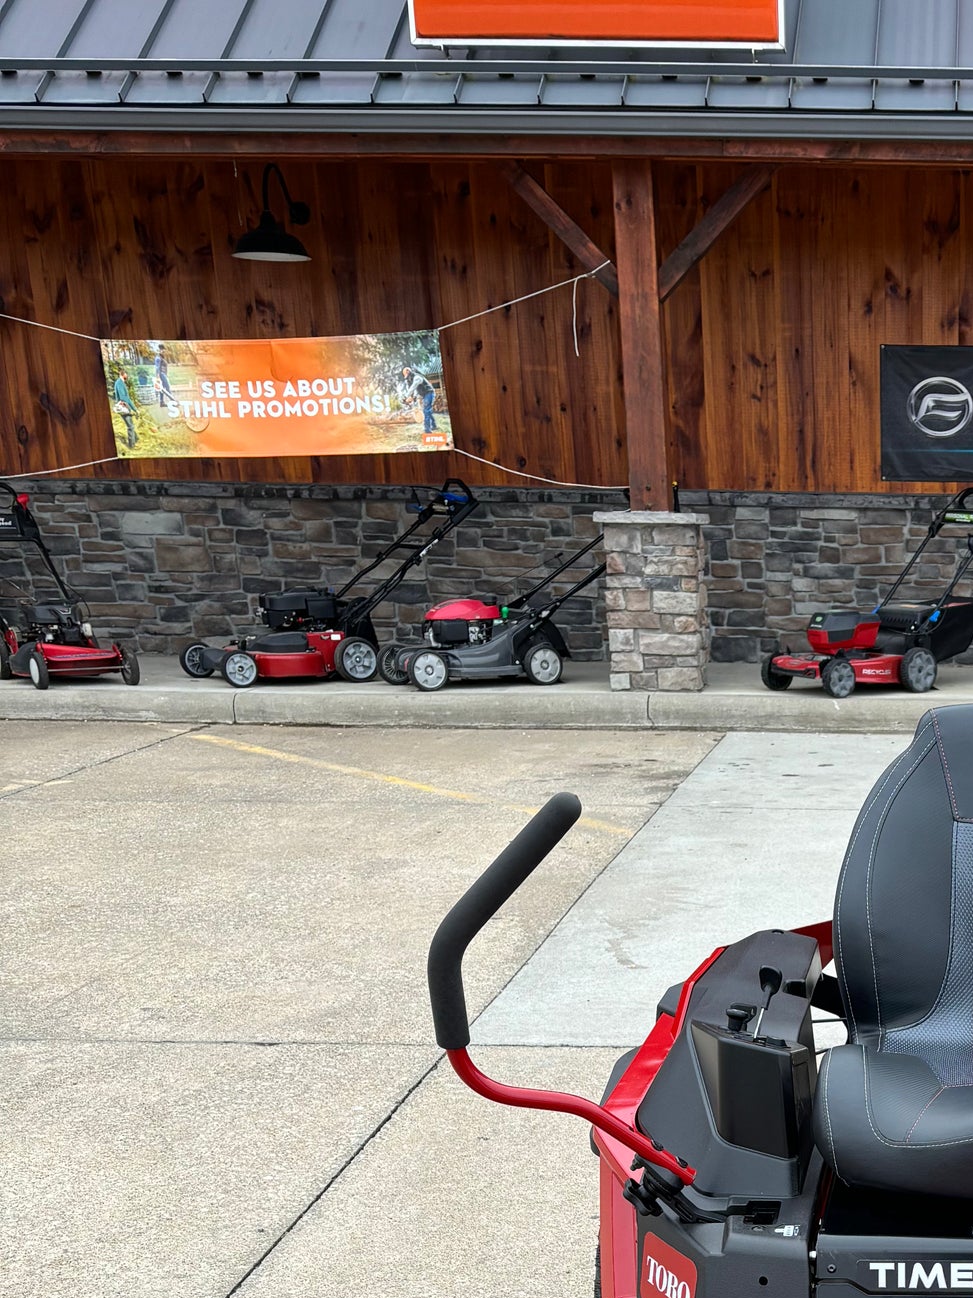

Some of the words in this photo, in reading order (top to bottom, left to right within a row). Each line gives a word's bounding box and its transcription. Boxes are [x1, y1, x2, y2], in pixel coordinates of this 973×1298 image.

[201, 381, 241, 399] SEE
[249, 380, 276, 398] US
[283, 377, 355, 397] ABOUT
[167, 400, 231, 418] STIHL
[238, 394, 391, 418] PROMOTIONS!
